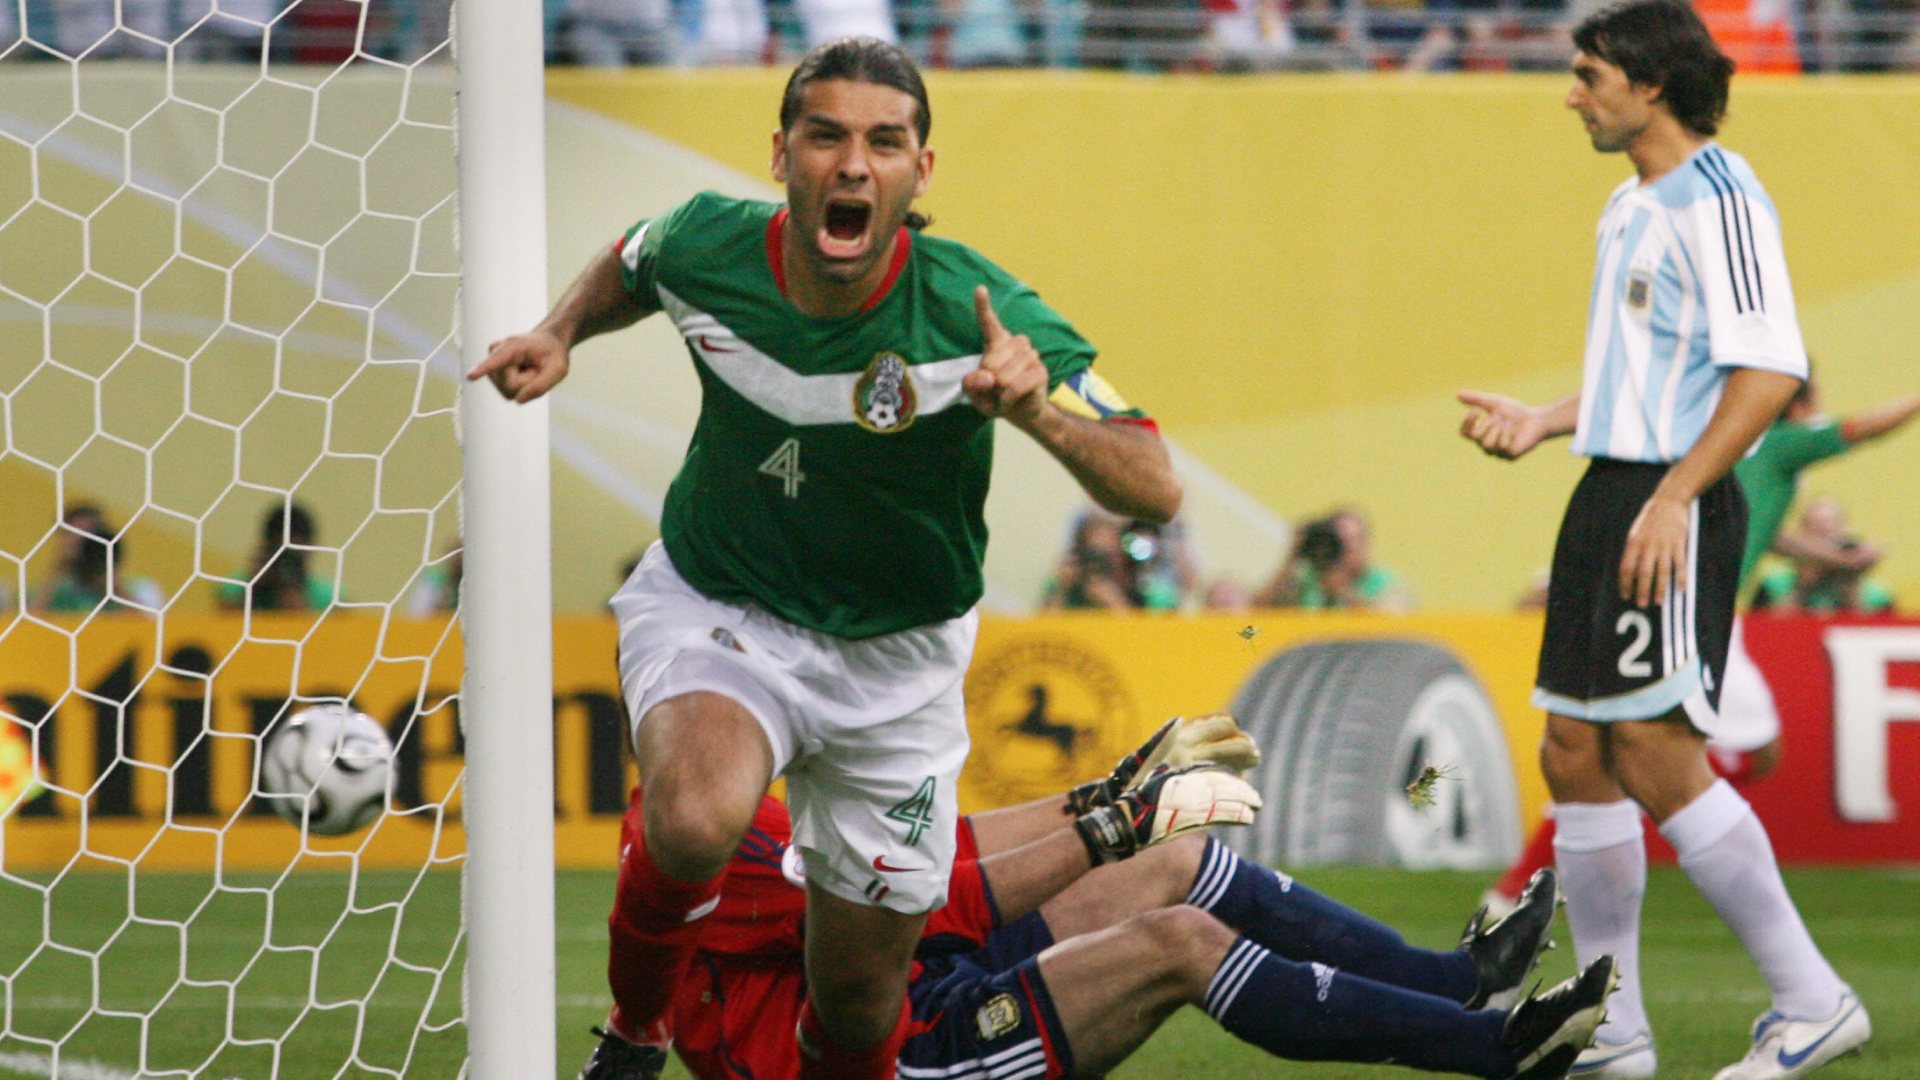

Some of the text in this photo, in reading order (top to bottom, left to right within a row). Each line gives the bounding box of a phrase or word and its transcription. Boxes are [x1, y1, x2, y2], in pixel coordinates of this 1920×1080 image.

[758, 438, 806, 498] 4
[1616, 610, 1652, 678] 2
[885, 776, 933, 846] 4
